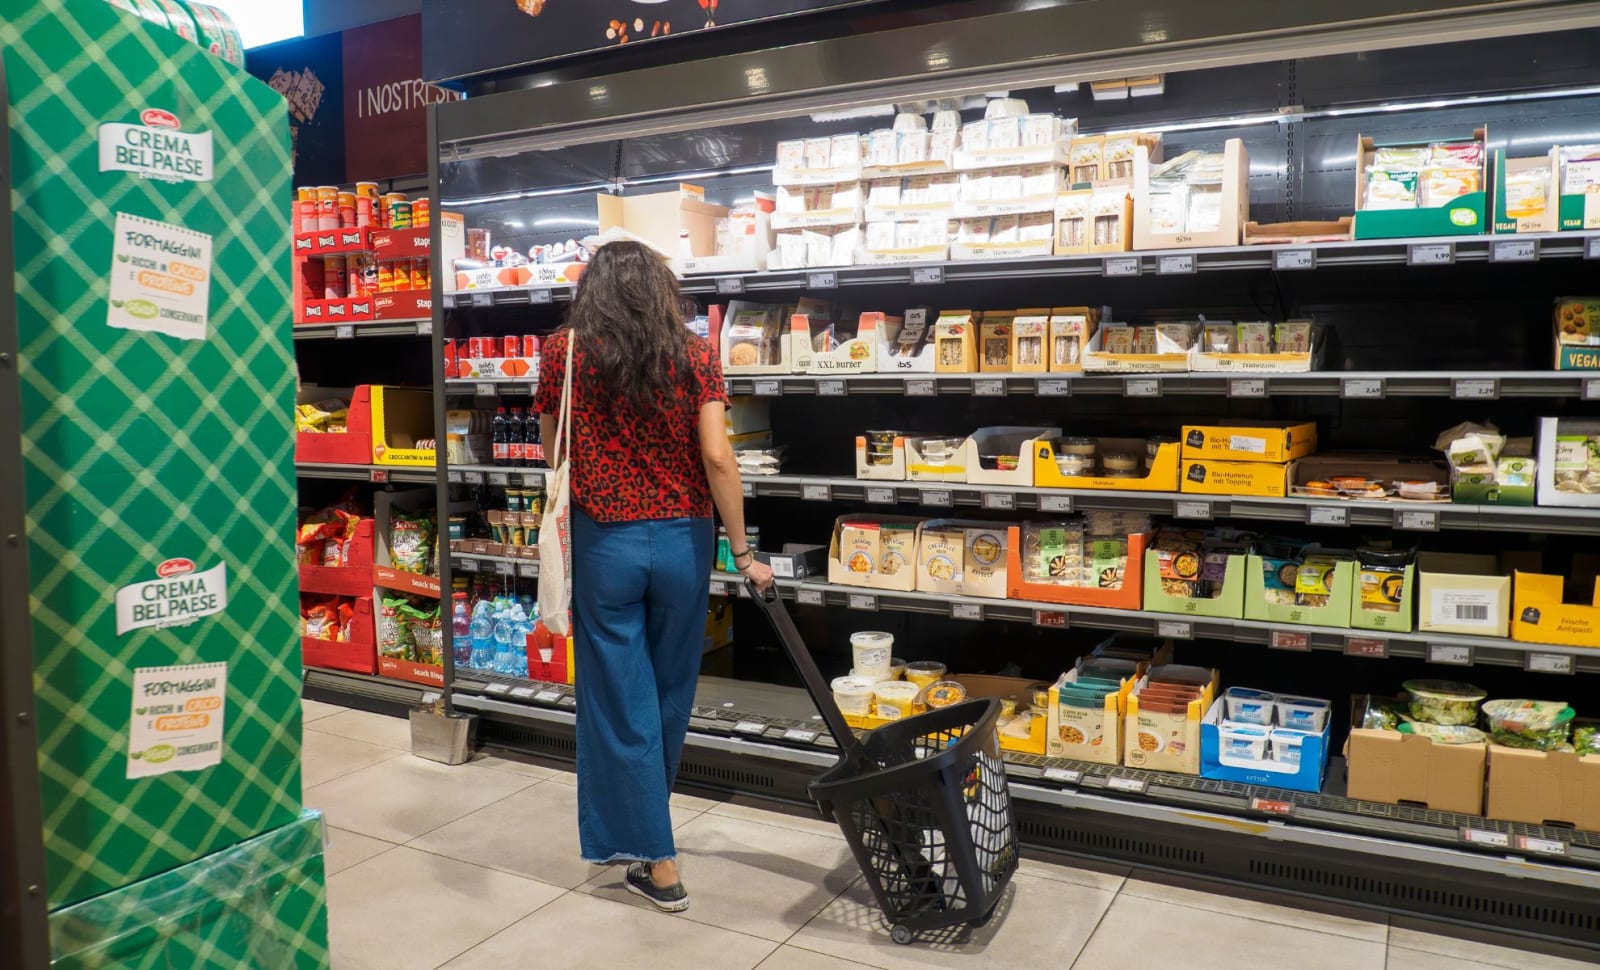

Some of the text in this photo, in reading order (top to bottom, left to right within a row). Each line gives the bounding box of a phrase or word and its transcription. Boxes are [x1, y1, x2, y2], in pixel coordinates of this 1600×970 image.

[358, 88, 363, 118] I
[367, 78, 429, 117] NOSTRI
[124, 128, 192, 156] CREMA
[1496, 222, 1516, 231] VEGAN
[1563, 218, 1582, 227] VEGAN
[125, 231, 202, 260] FORMAGGINI
[817, 360, 834, 369] XXL
[1569, 352, 1600, 368] VEGA
[1210, 436, 1232, 444] Bio-Hu
[141, 577, 207, 601] CREMA
[1556, 624, 1593, 634] Antipasti
[143, 677, 216, 697] FORMAGGINI
